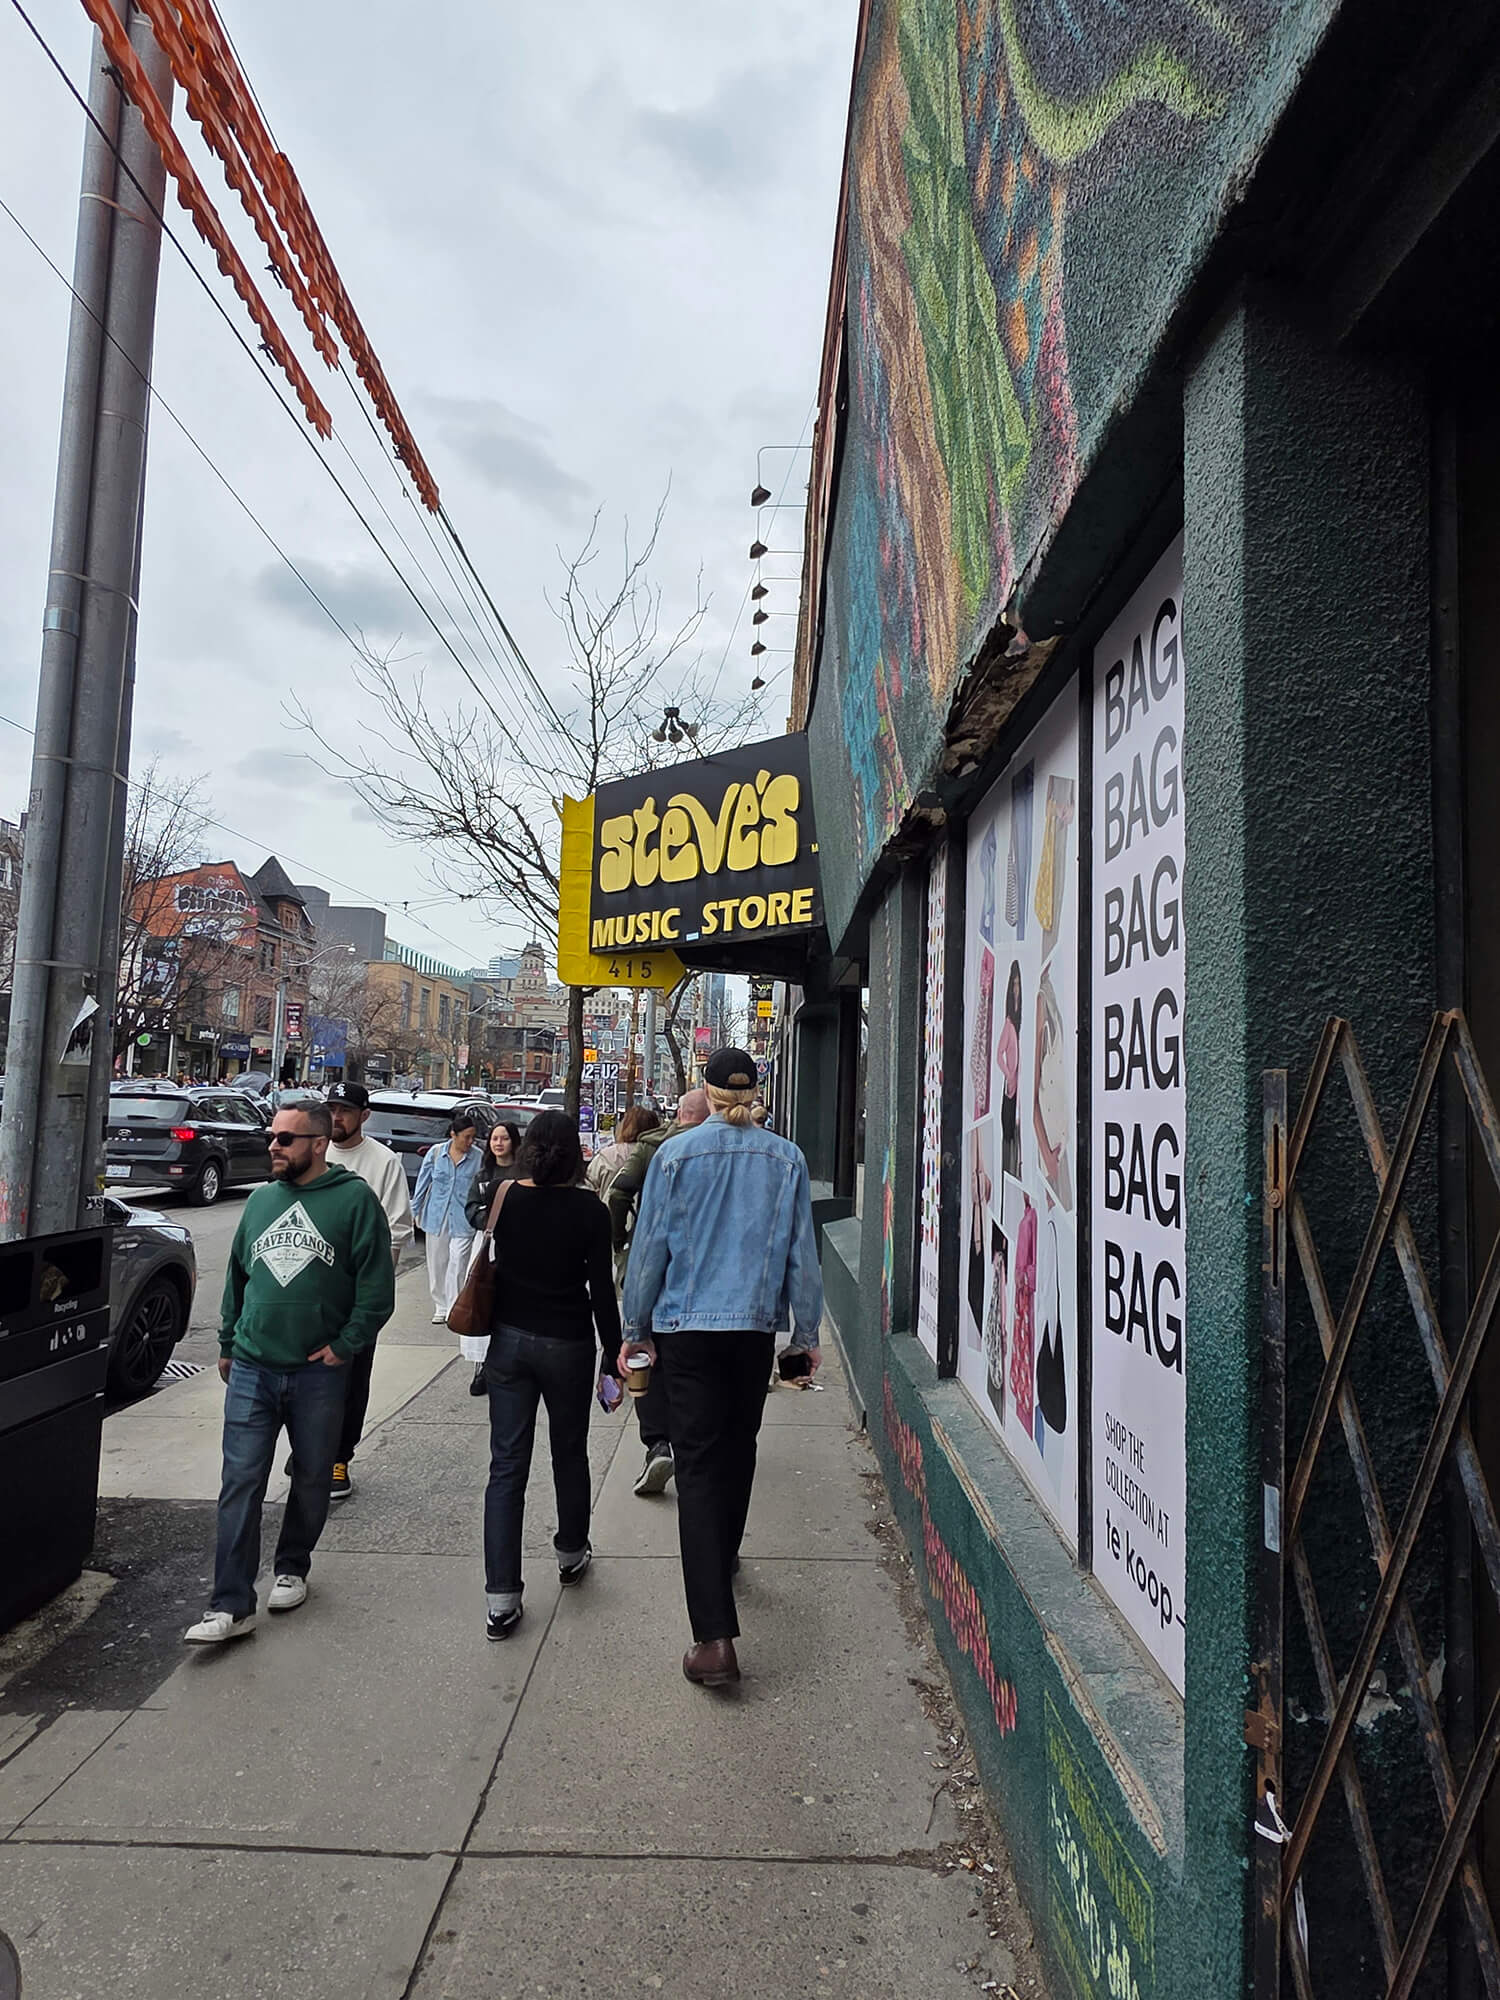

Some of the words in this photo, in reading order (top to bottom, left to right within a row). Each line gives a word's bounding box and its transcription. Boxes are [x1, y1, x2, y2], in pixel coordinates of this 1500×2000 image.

[1104, 598, 1178, 753] BAG
[1104, 725, 1178, 864] BAG
[592, 907, 681, 948] MUSIC
[701, 888, 814, 935] STORE
[1104, 855, 1179, 976] BAG
[608, 960, 653, 978] 415
[601, 1063, 619, 1079] U2
[1104, 988, 1180, 1092] BAG
[1105, 1122, 1181, 1230] BAG
[1105, 1240, 1182, 1374] BAG
[1105, 1412, 1127, 1453] SHOP
[1128, 1431, 1144, 1474] THE
[1105, 1456, 1155, 1533] COLLECTION
[1157, 1508, 1169, 1548] AT
[1106, 1509, 1121, 1560] te
